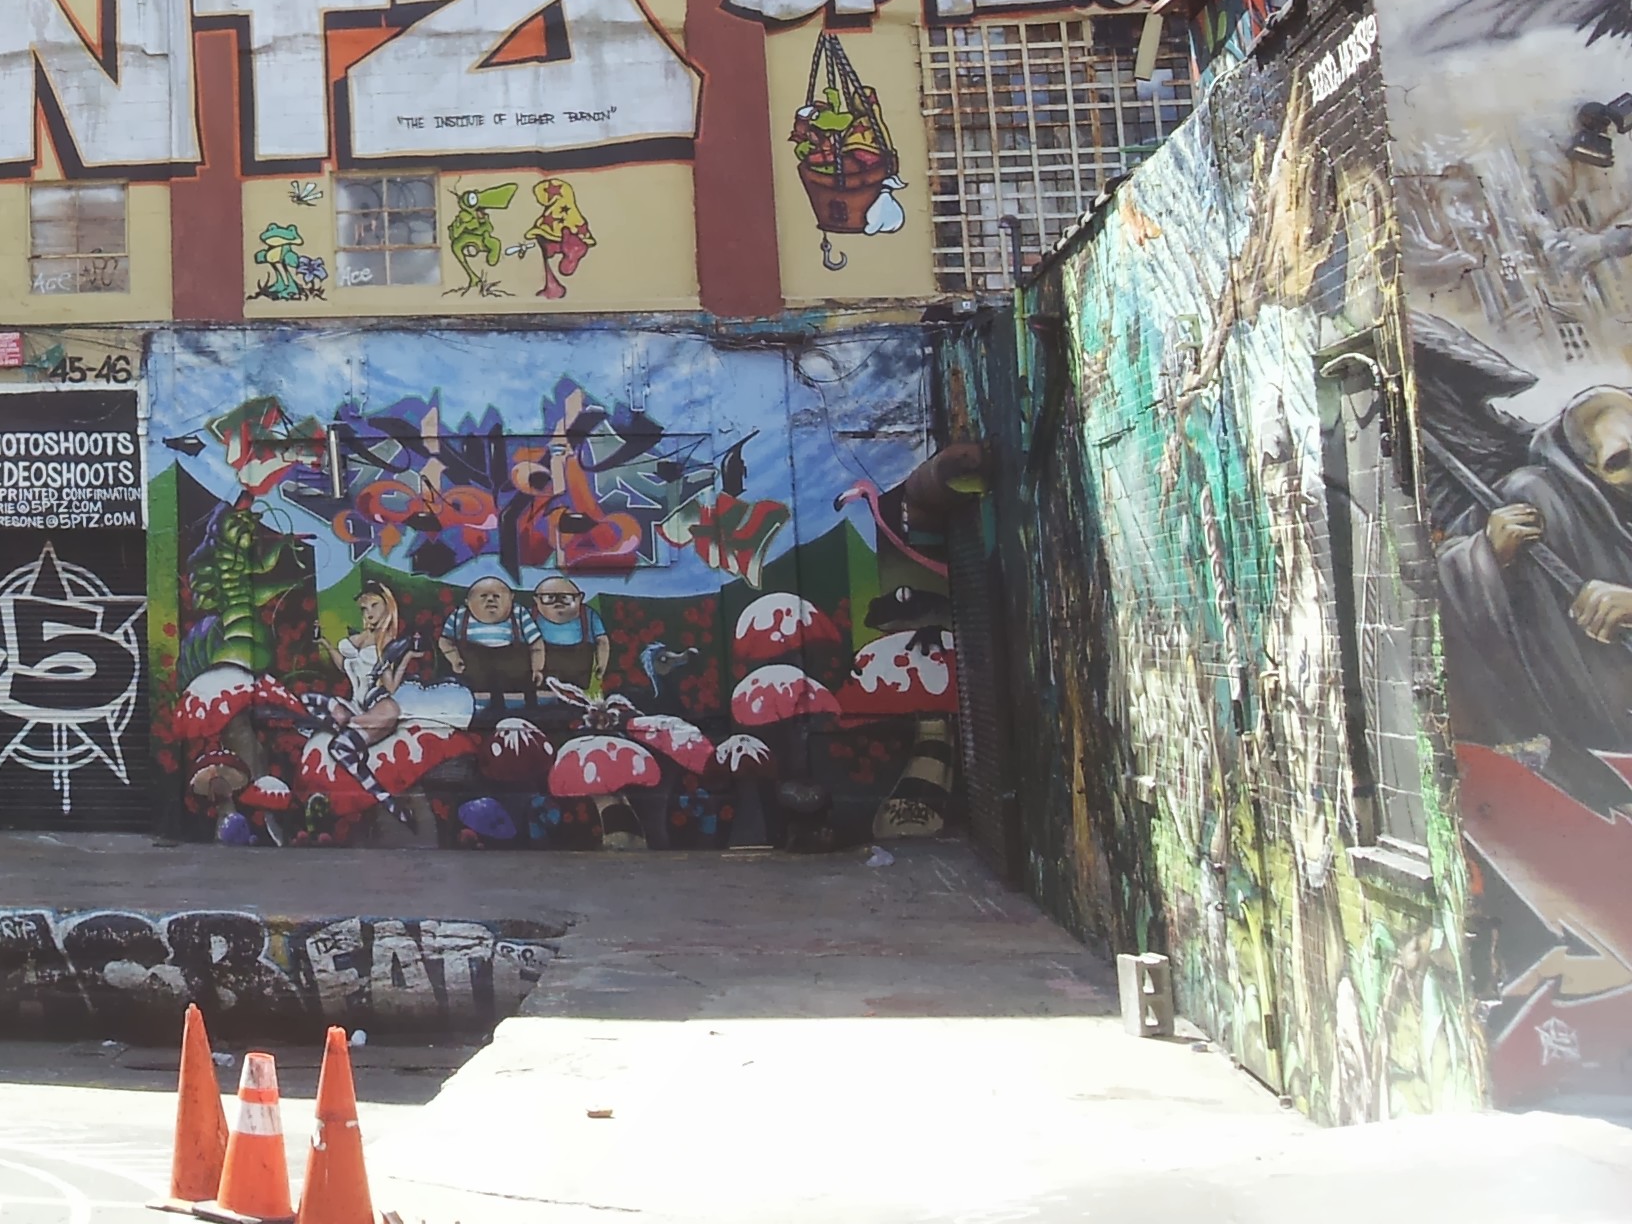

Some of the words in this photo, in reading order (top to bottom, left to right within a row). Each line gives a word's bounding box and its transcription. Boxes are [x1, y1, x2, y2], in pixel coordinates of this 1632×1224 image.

[493, 112, 507, 126] OF
[50, 355, 133, 384] 45-46
[61, 485, 142, 502] CONFIRMATION
